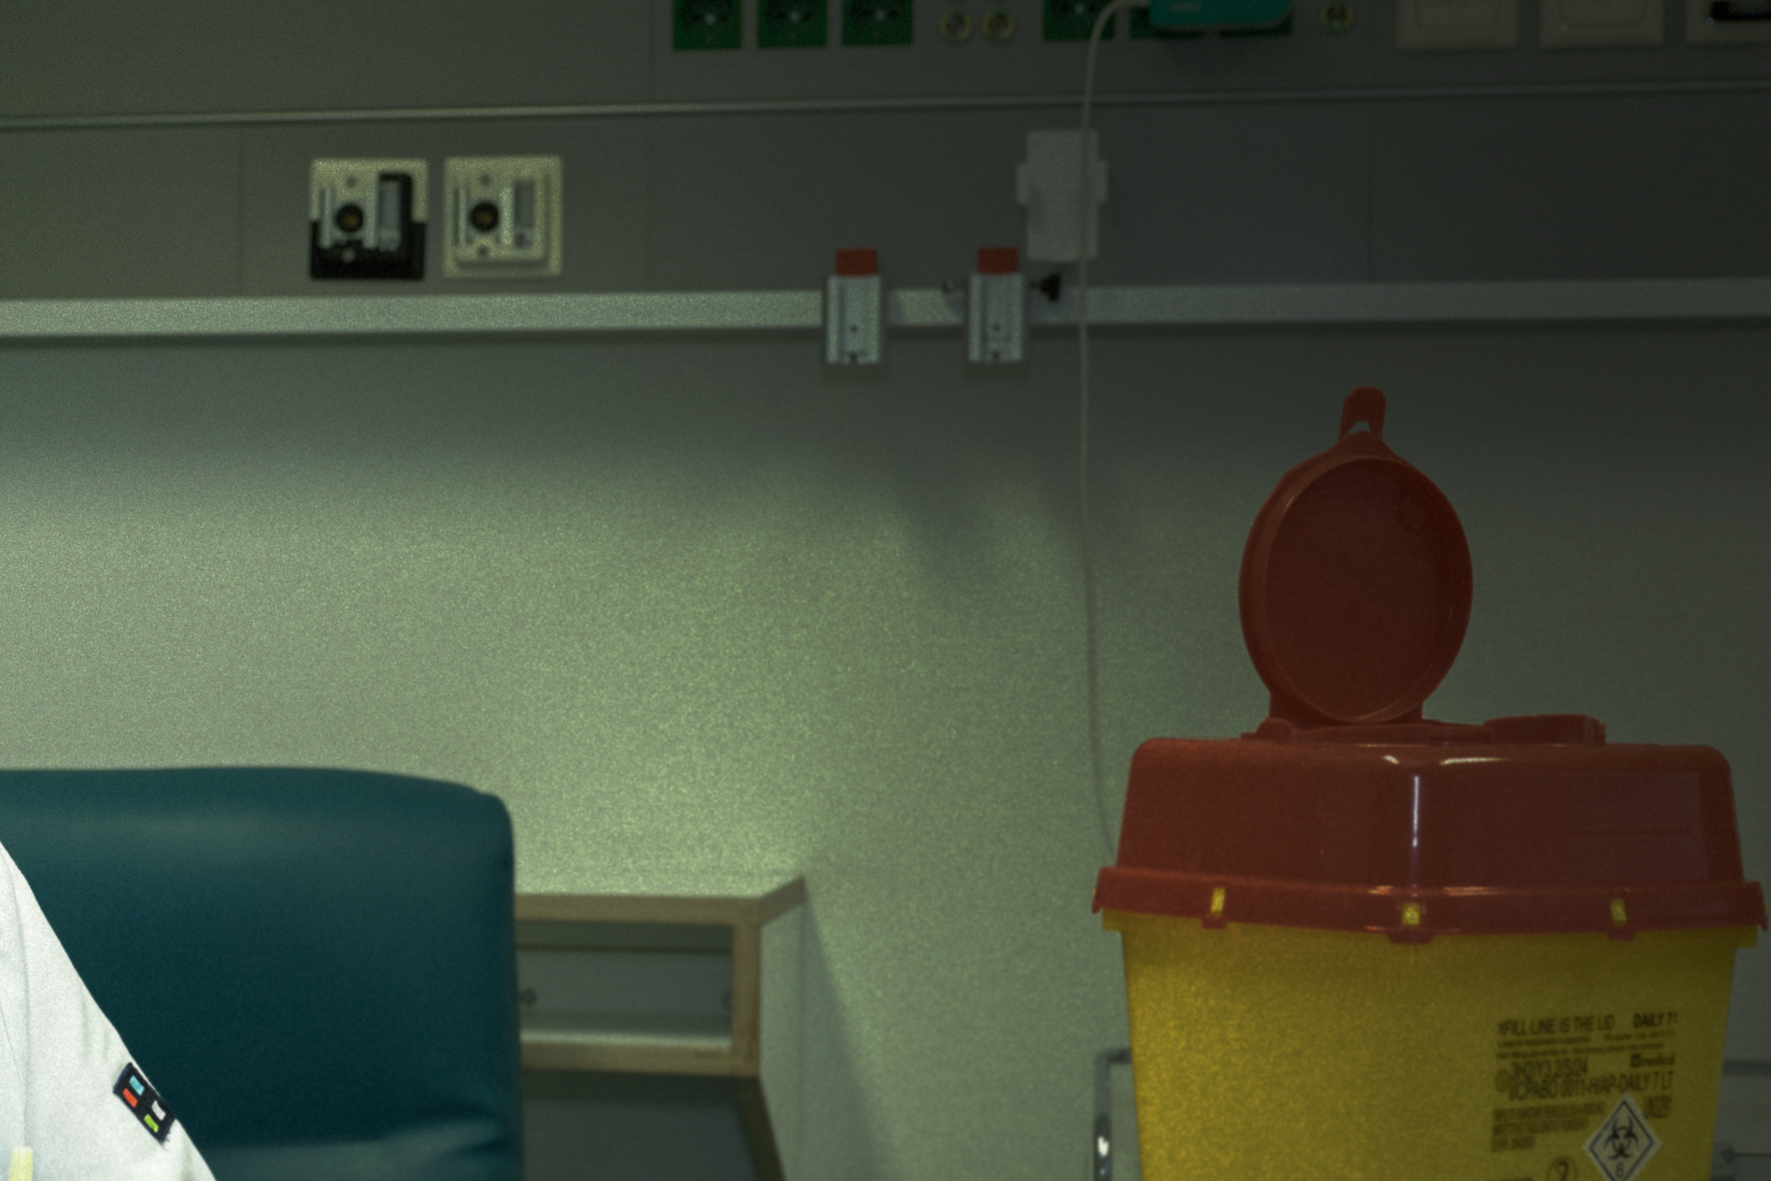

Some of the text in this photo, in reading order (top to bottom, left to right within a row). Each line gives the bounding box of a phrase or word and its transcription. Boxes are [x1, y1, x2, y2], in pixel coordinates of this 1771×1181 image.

[1559, 1016, 1570, 1033] IS
[1572, 1015, 1595, 1032] THE
[1597, 1014, 1615, 1031] LID
[1633, 1012, 1664, 1029] DAILY
[1652, 1072, 1660, 1091] 7
[1661, 1071, 1674, 1090] LT
[1615, 1162, 1625, 1180] 6
